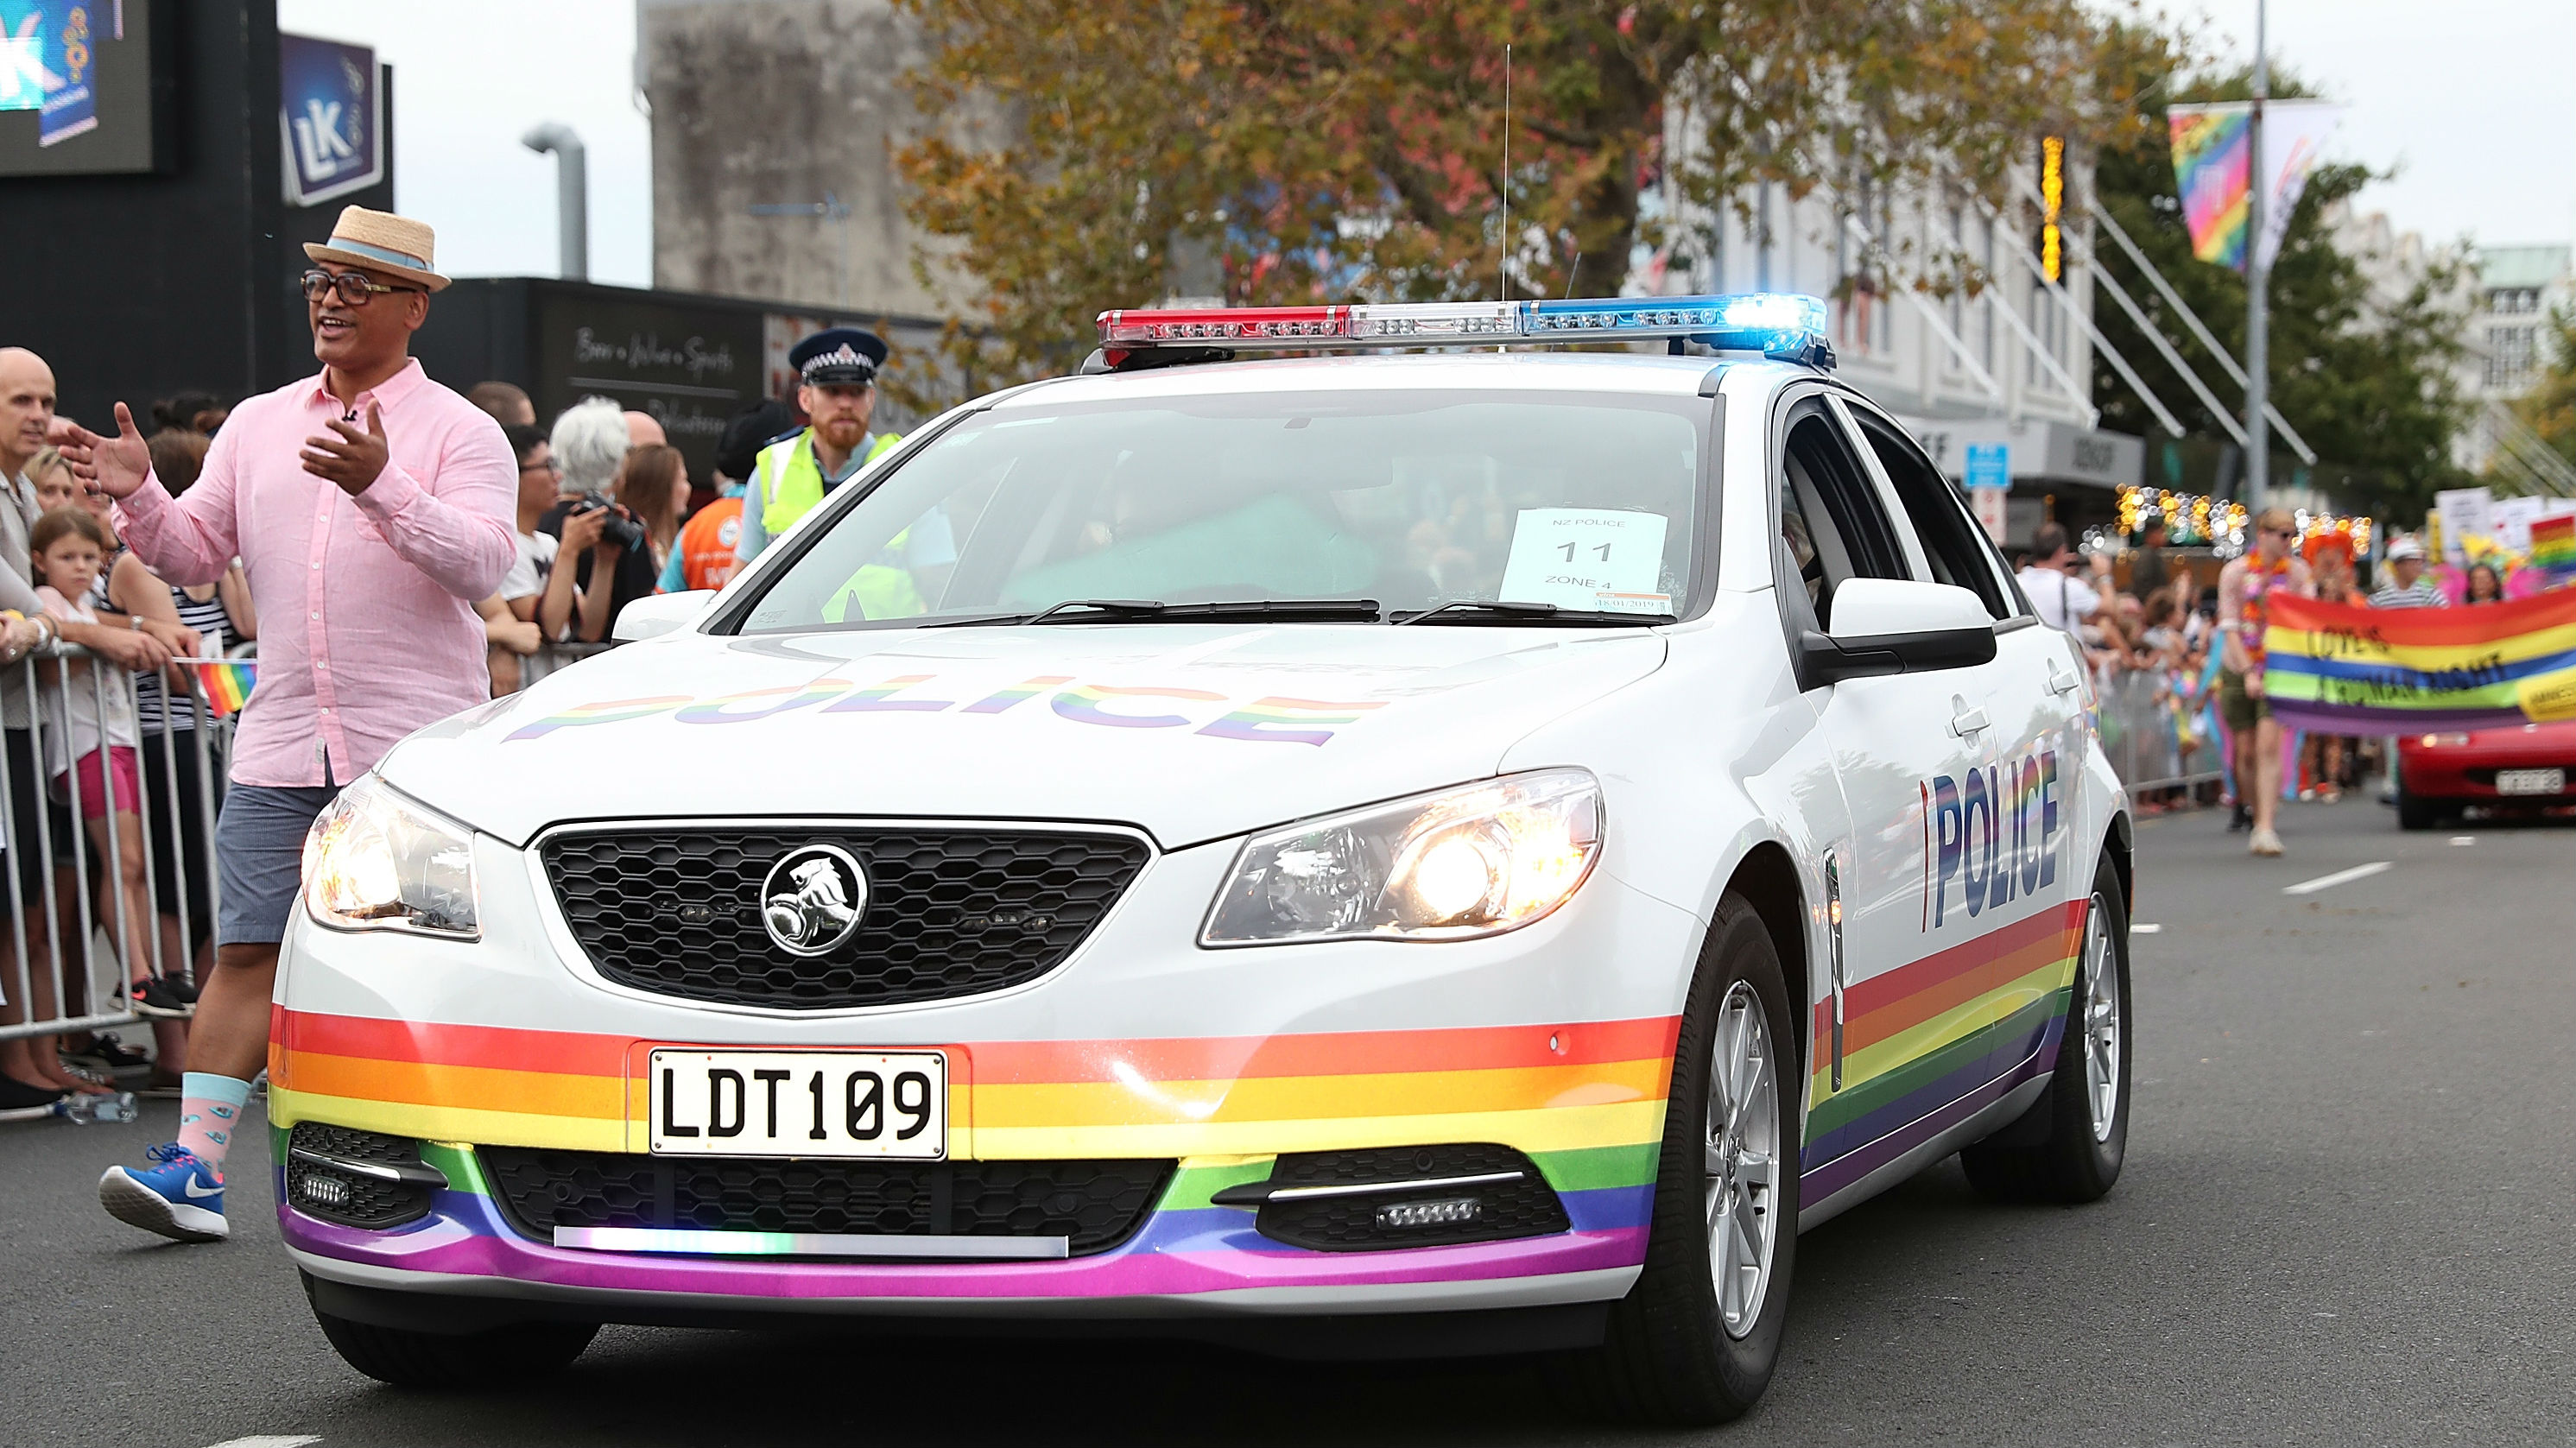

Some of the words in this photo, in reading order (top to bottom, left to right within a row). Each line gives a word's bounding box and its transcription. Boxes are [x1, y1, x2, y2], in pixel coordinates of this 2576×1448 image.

[293, 98, 353, 183] LK
[1556, 541, 1612, 563] 11
[1574, 518, 1626, 528] POLICE
[1545, 575, 1597, 588] ZONE
[498, 673, 1389, 749] POLICE
[1933, 750, 2058, 929] POLICE
[662, 1068, 932, 1141] LDT109
